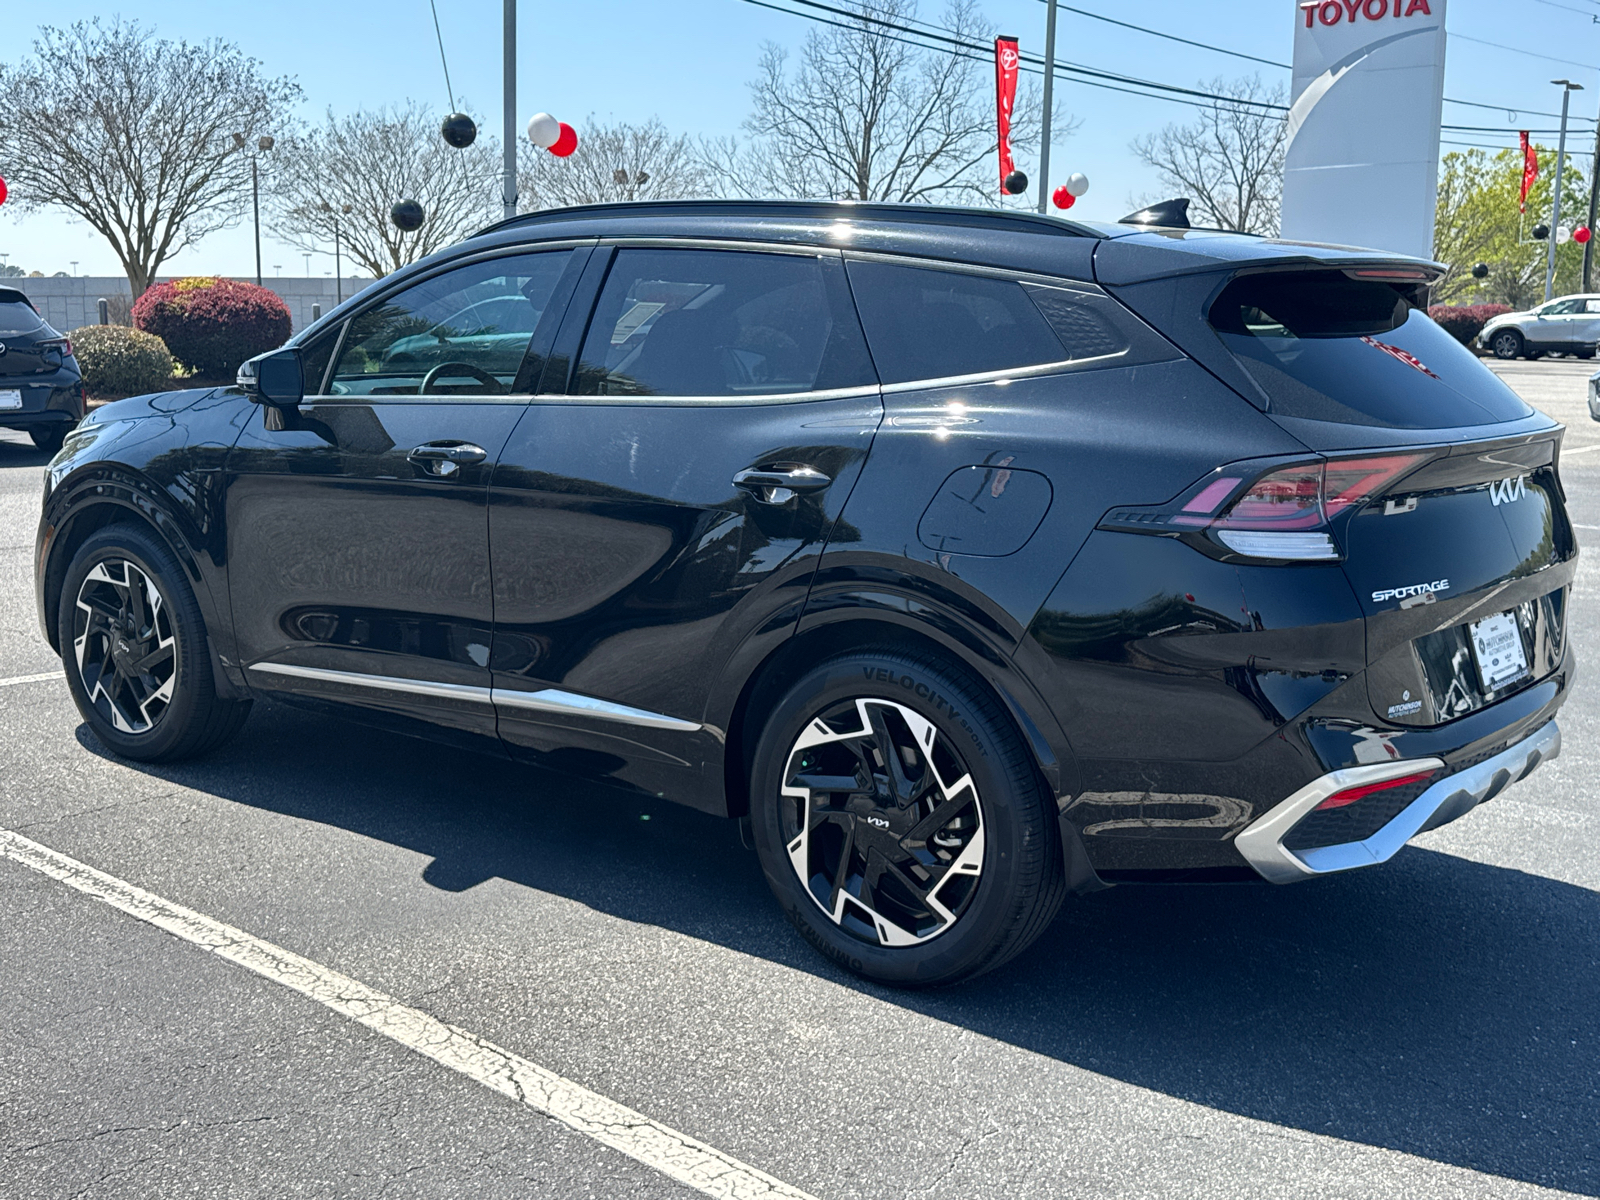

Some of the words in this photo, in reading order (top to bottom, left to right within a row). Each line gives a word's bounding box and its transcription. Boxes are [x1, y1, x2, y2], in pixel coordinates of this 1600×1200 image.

[1300, 0, 1431, 28] TOYOTA
[1490, 474, 1526, 507] KIA
[1371, 579, 1450, 602] SPORTAGE
[862, 666, 961, 721] VELOCITY
[959, 718, 989, 757] SPORT
[1387, 700, 1422, 714] HUTCHINSON
[787, 903, 863, 971] OMNIMAX
